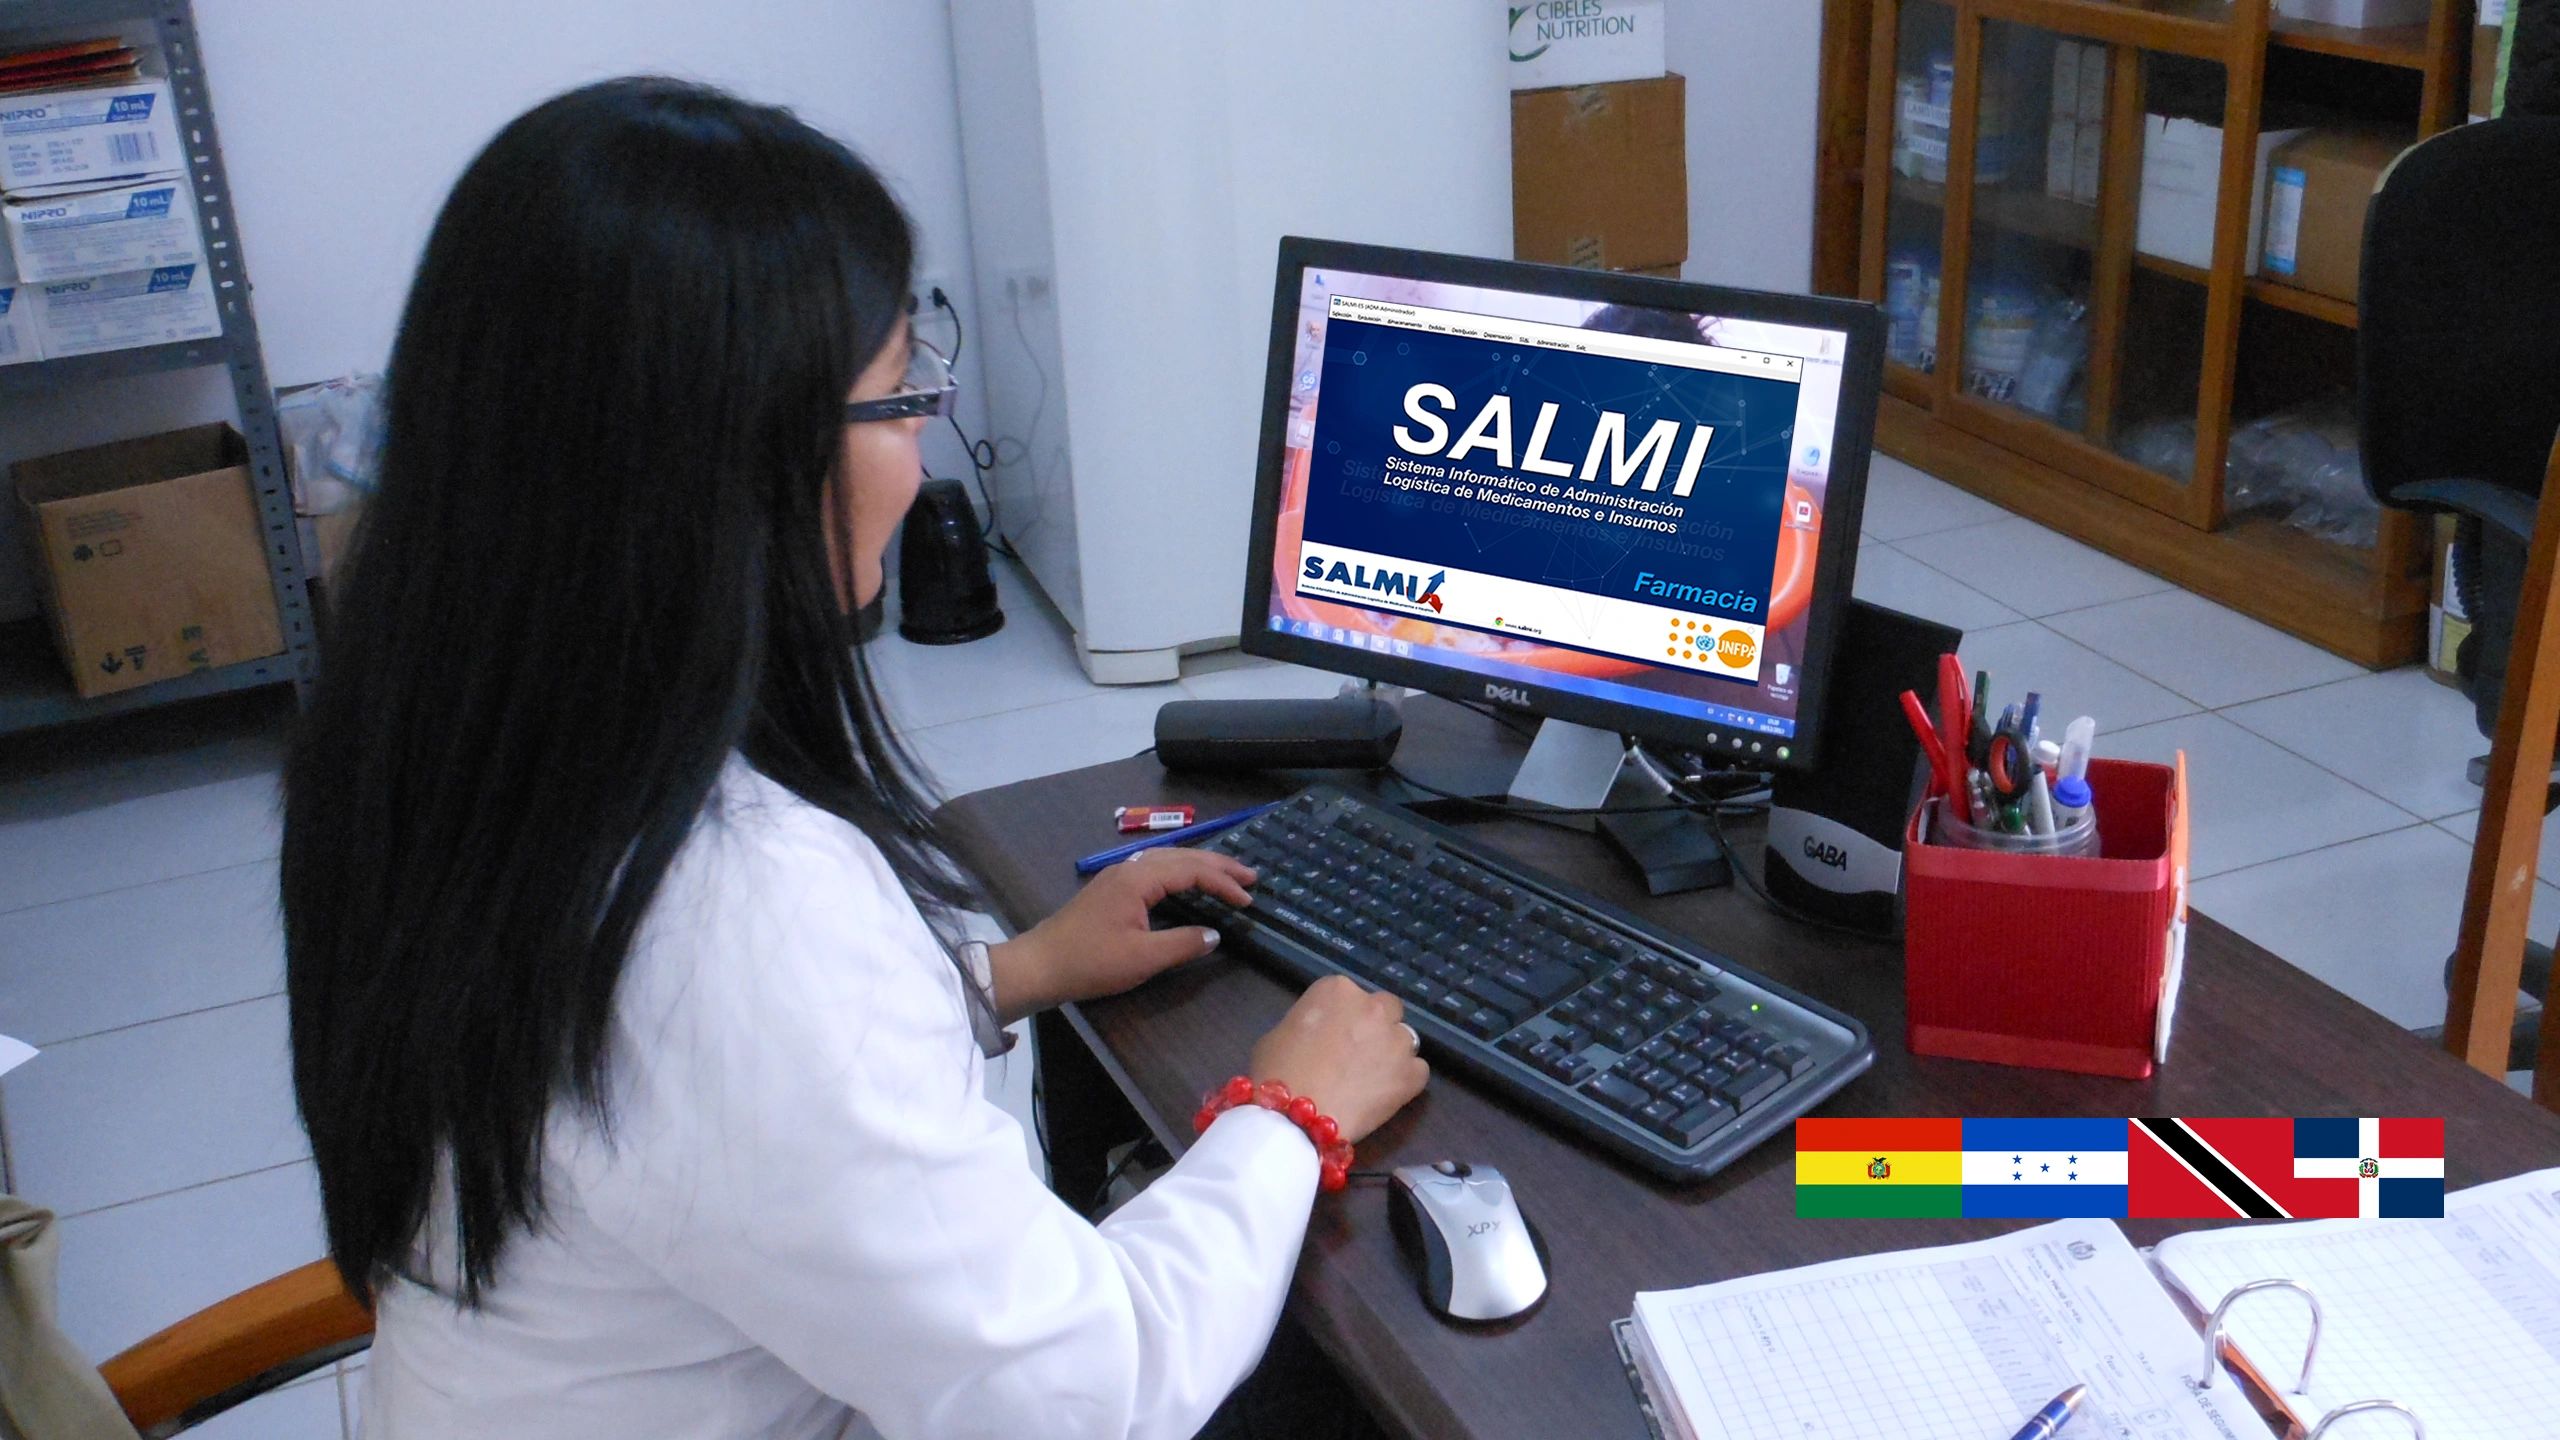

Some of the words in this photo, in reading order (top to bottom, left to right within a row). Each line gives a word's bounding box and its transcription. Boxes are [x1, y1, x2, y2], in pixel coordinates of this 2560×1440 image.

[1536, 0, 1602, 20] CIBELES
[1537, 15, 1634, 40] NUTRITION
[0, 107, 46, 121] NIPRO
[132, 195, 148, 207] 10
[149, 194, 168, 206] mL
[20, 207, 67, 221] NIPRO
[154, 270, 169, 282] 10
[171, 270, 188, 281] mL
[1392, 382, 1715, 498] SALMI
[1385, 456, 1445, 478] Sistema
[1448, 466, 1536, 493] Informático
[1540, 483, 1559, 496] de
[1562, 486, 1685, 518] Administración
[1383, 472, 1451, 495] Logística
[1454, 485, 1473, 499] de
[1476, 488, 1591, 519] Medicamentos
[1594, 511, 1605, 521] e
[1608, 510, 1678, 534] Insumos
[1303, 555, 1419, 603] SALMI
[1633, 571, 1758, 613] Farmacia
[1716, 639, 1756, 659] UNFPA
[1485, 683, 1531, 706] DELL
[1804, 835, 1847, 871] GABA
